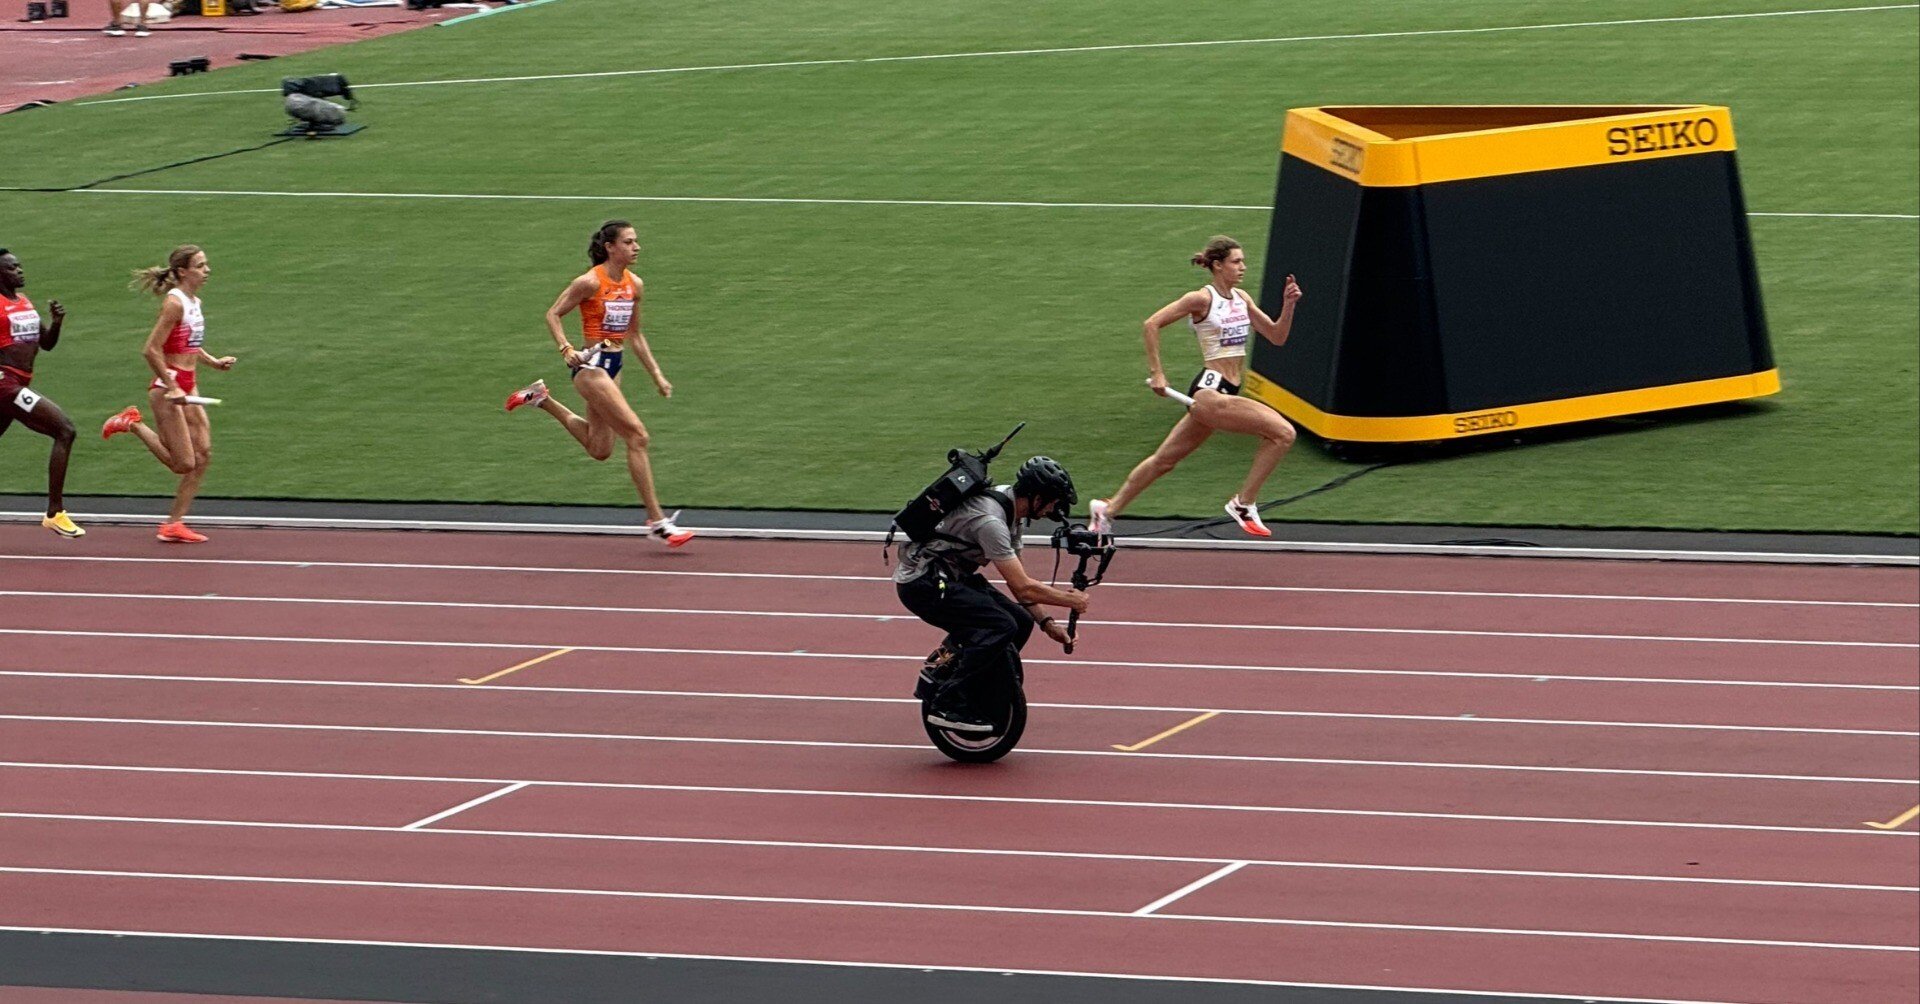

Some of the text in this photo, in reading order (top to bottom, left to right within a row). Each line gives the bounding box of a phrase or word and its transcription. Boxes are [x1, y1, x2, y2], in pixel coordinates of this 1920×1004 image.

[1606, 118, 1718, 156] SEIKO
[1204, 373, 1215, 386] 8
[21, 394, 34, 405] 6
[1453, 411, 1519, 433] SEIKO
